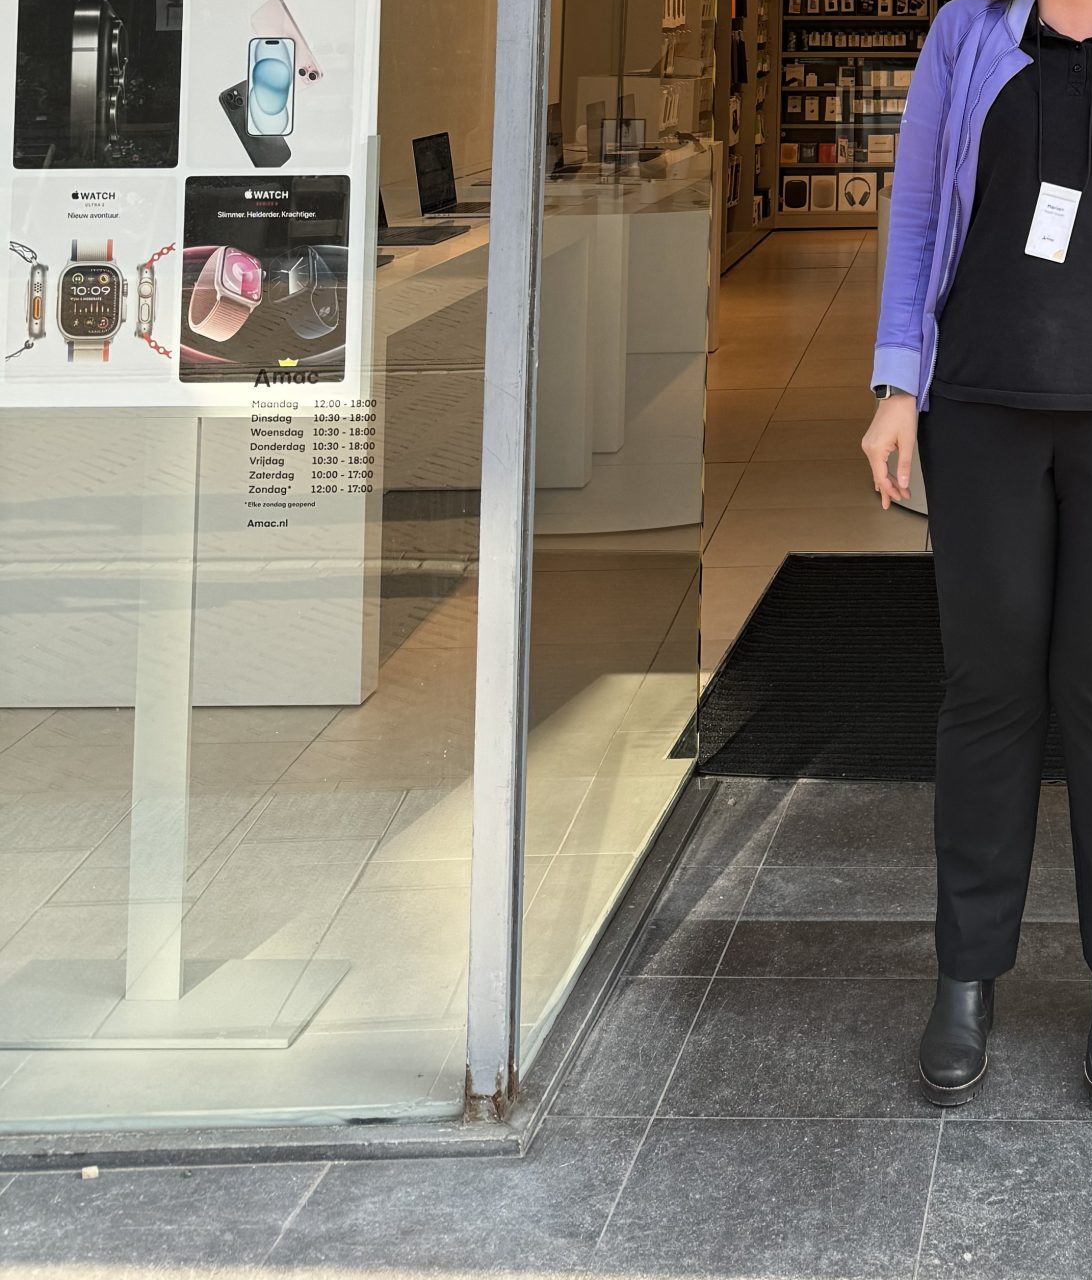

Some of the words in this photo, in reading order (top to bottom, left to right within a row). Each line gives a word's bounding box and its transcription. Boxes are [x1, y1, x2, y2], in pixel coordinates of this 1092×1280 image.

[80, 192, 115, 200] WATCH
[254, 190, 289, 199] WATCH
[281, 211, 316, 219] Krachtiger.
[70, 286, 111, 296] 10:09
[254, 368, 319, 388] Amac
[252, 400, 299, 410] Maandag
[314, 400, 341, 408] 12:00
[351, 400, 377, 408] 18:00
[252, 414, 292, 424] Dinsdag
[314, 414, 340, 422] 10:30
[350, 414, 377, 422] 18:00
[250, 428, 304, 438] Woensdag
[313, 428, 339, 436] 10:30
[349, 428, 376, 436] 18:00
[250, 442, 306, 452] Donderdag
[313, 442, 339, 450] 10:30
[349, 442, 375, 450] 18:00
[250, 456, 284, 467] Vrijdag
[312, 456, 338, 465] 10:30
[348, 456, 375, 465] 18:00
[249, 471, 295, 481] Zaterdag
[311, 471, 338, 479] 10:00
[348, 470, 374, 479] 17:00
[311, 485, 338, 493] 12:00
[347, 484, 373, 493] 17:00
[247, 519, 288, 528] Amac.nl
